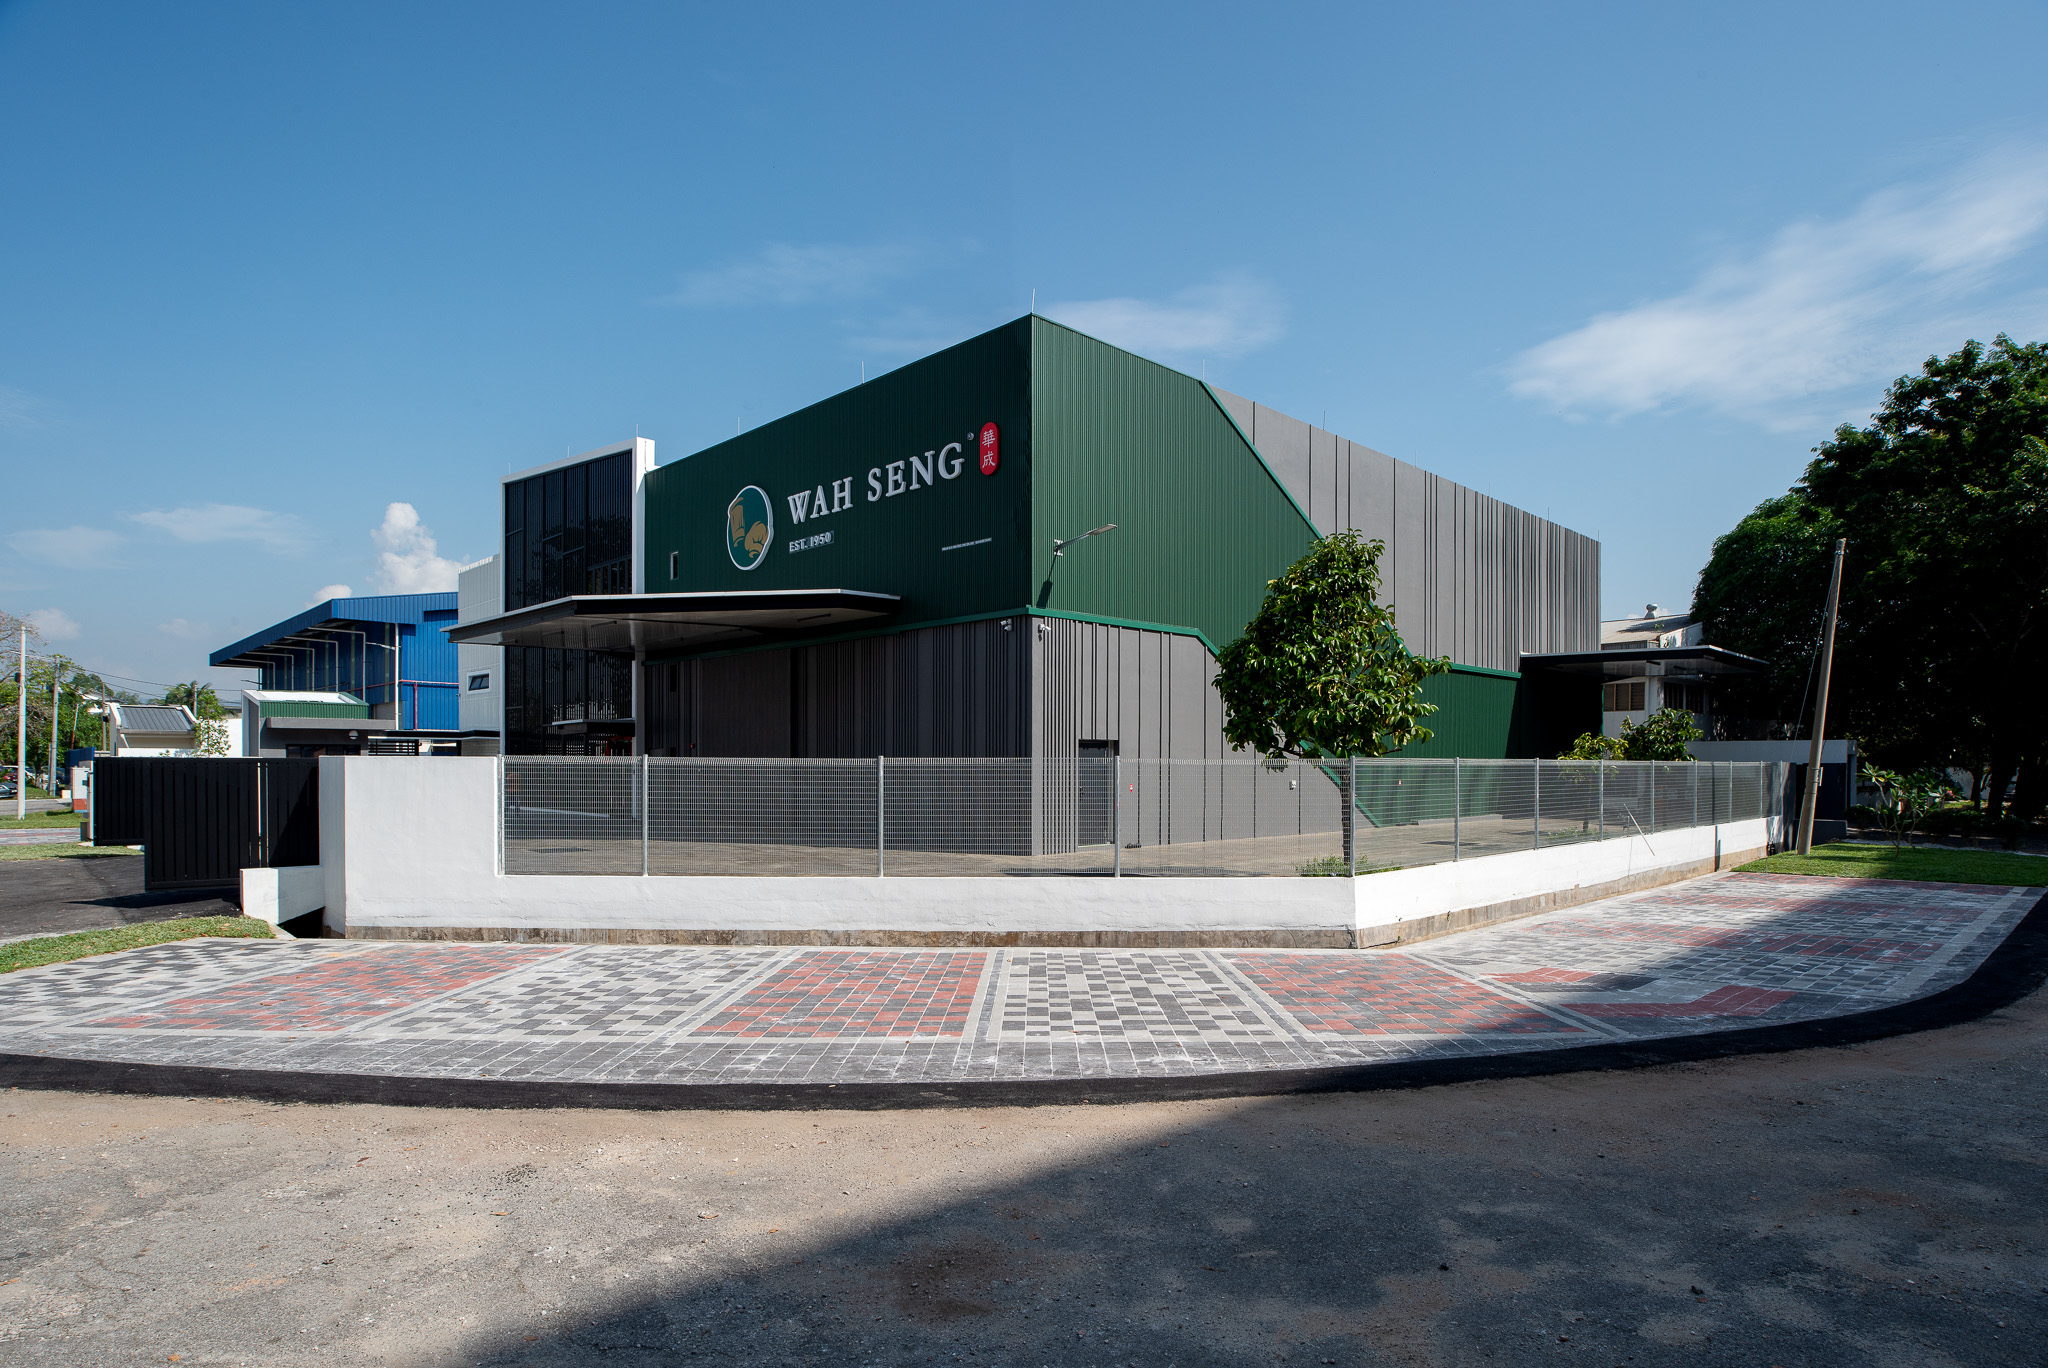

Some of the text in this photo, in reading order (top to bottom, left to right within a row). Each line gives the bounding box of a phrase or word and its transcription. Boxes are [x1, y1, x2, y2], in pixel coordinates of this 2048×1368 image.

[982, 429, 996, 469] 華成
[787, 442, 965, 525] WAH SENG
[789, 531, 832, 552] EST. 1950
